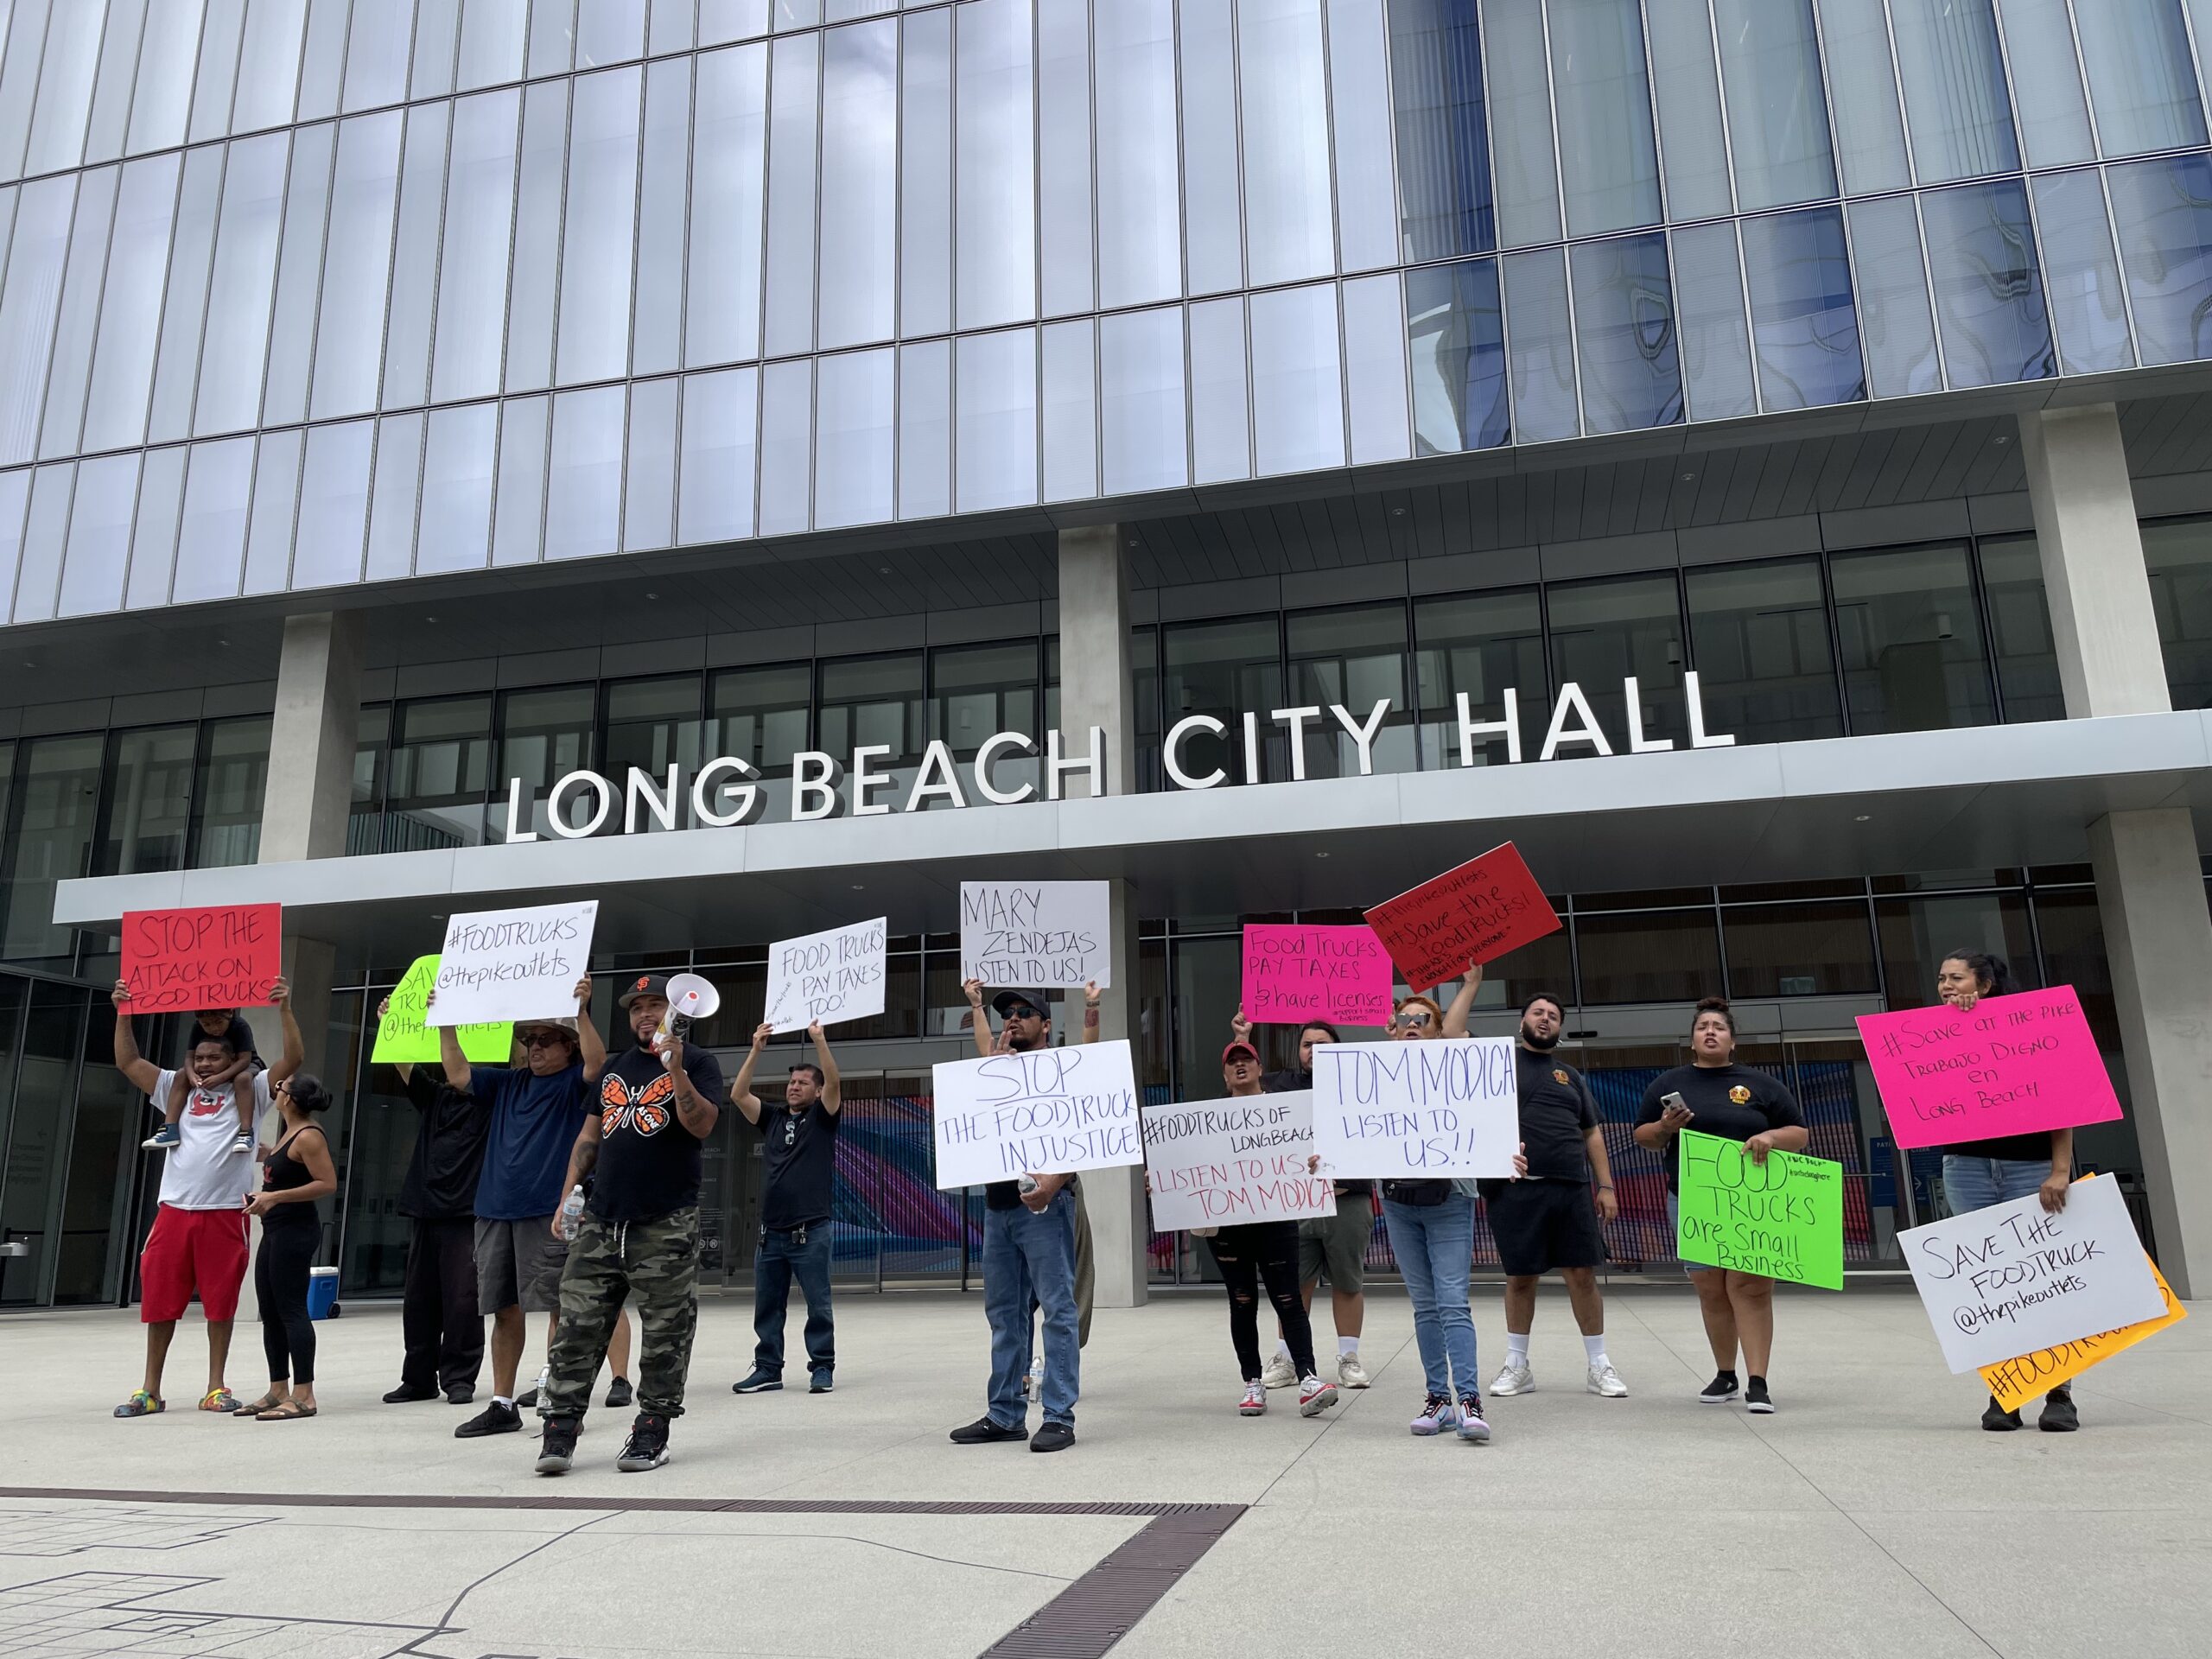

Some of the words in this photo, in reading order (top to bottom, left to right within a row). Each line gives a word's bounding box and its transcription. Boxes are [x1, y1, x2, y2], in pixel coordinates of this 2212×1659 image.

[505, 756, 764, 845] LONG
[791, 725, 1108, 822] BEACH
[1162, 697, 1393, 790] CITY
[1455, 671, 1736, 767] HALL
[963, 887, 1041, 931] MARY
[1455, 886, 1503, 916] the
[130, 913, 213, 958] STOP
[220, 911, 264, 949] THE
[448, 917, 578, 953] #FOODTRUCKS
[782, 943, 830, 977] FOOD
[836, 927, 884, 964] TRUCKS
[982, 931, 1096, 957] ZENDEJAS
[1250, 931, 1306, 955] Food
[1306, 932, 1377, 957] Trucks
[128, 960, 207, 990] ATTACK
[216, 954, 252, 979] ON
[803, 970, 830, 997] PAY
[836, 963, 881, 992] TAXES
[1024, 959, 1045, 983] TO
[1053, 957, 1085, 982] US!
[1249, 957, 1284, 976] PAY
[1292, 958, 1360, 981] TAXES
[129, 988, 189, 1015] FOOD
[197, 980, 270, 1007] TRUCKS
[804, 992, 847, 1020] TOO!
[1274, 984, 1319, 1008] have
[1326, 982, 1384, 1009] licenses
[1879, 1020, 1962, 1058] #Save
[976, 1048, 1082, 1102] STOP
[1318, 1047, 1415, 1105] TOM
[1420, 1044, 1516, 1106] MODICA
[1967, 1069, 1999, 1084] en
[938, 1111, 988, 1145] THE
[994, 1089, 1138, 1137] FOODTRUCK
[1269, 1106, 1291, 1123] OF
[1342, 1111, 1419, 1139] LISTEN
[1427, 1109, 1458, 1133] TO
[1404, 1128, 1474, 1168] US!!
[1683, 1132, 1789, 1193] FOOD
[1156, 1163, 1228, 1193] LISTEN
[1232, 1160, 1263, 1183] TO
[1271, 1154, 1306, 1176] US
[1187, 1186, 1255, 1220] TOM
[1257, 1178, 1336, 1214] MODICA
[1697, 1185, 1815, 1226] TRUCKS
[1682, 1216, 1726, 1244] are
[1734, 1223, 1799, 1262] Small
[1922, 1235, 2004, 1280] SAVE
[1999, 1213, 2063, 1249] THE
[1717, 1243, 1804, 1281] Business
[1969, 1239, 2106, 1299] FOODTRUCK
[1953, 1274, 2088, 1336] @thepikeoutlets
